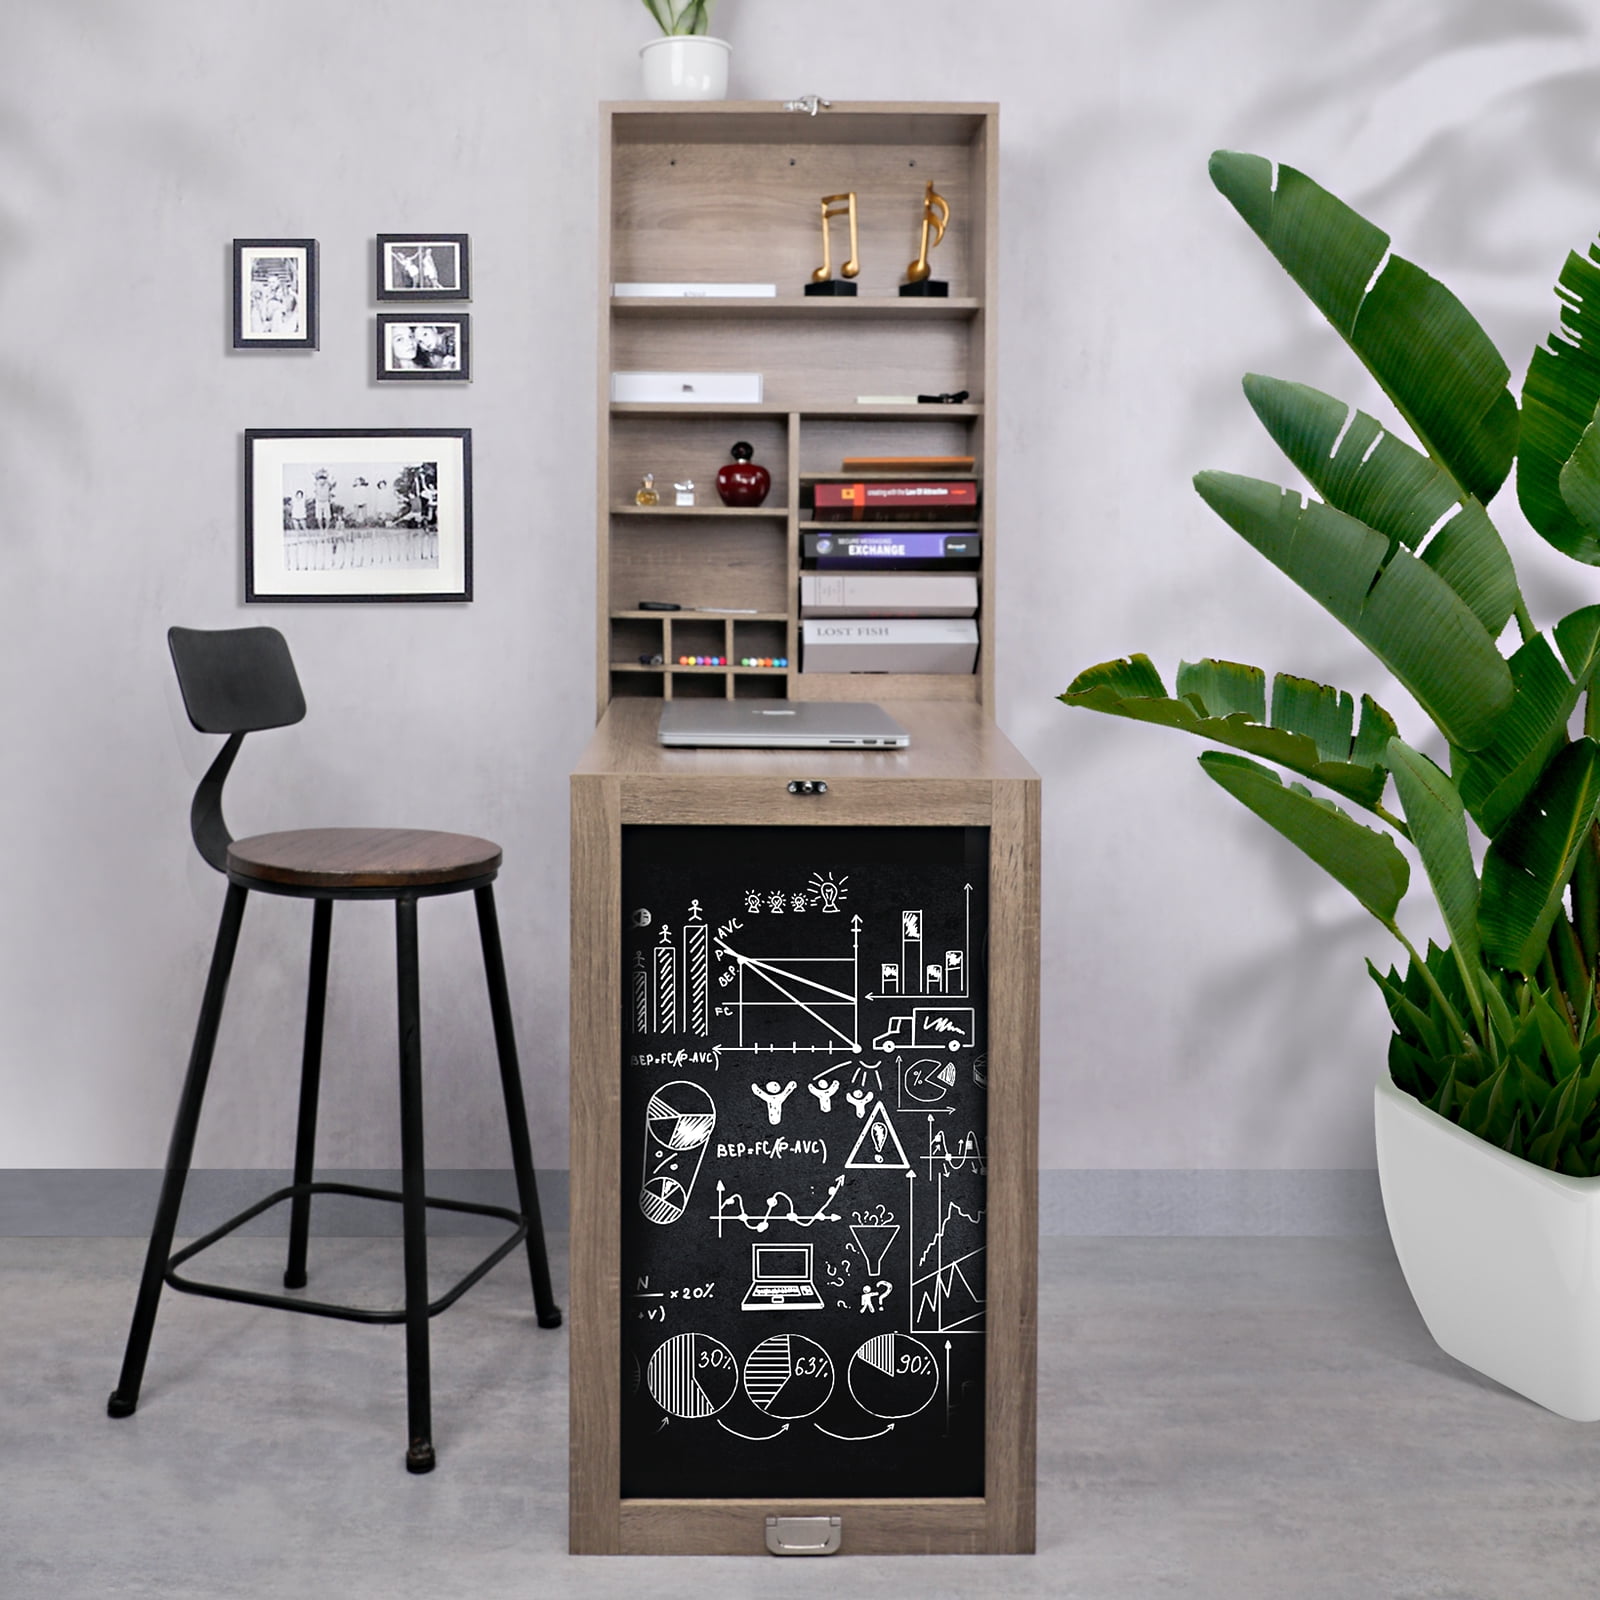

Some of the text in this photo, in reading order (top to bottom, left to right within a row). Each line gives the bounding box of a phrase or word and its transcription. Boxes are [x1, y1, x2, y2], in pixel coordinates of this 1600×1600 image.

[848, 545, 905, 555] EXCHANGE
[817, 627, 889, 636] LOST FISH
[718, 917, 744, 940] AVC
[715, 1006, 734, 1017] FC
[698, 1349, 732, 1371] 30%
[794, 1356, 829, 1379] 63%
[896, 1353, 932, 1376] 90%
